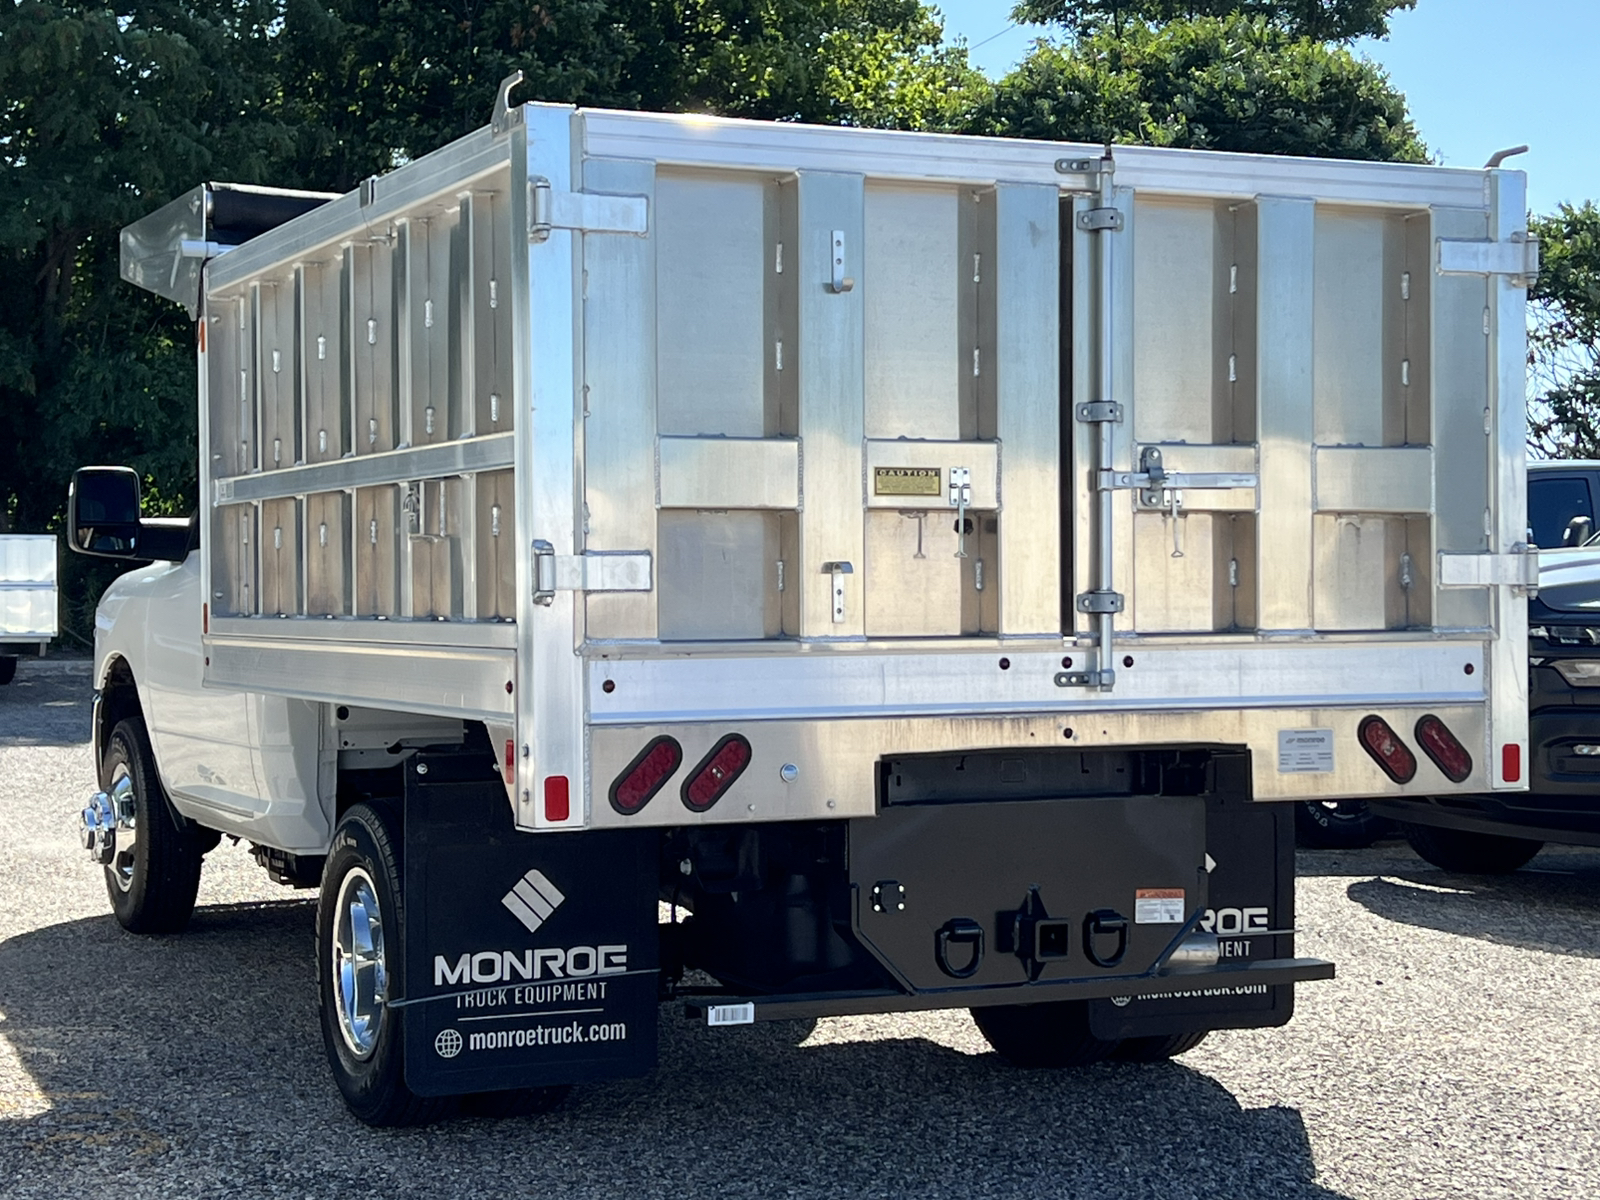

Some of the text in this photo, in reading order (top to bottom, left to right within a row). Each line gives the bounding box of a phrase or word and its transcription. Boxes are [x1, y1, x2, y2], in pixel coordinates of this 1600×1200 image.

[879, 469, 936, 477] CAUTION
[1200, 907, 1268, 933] ROE
[434, 945, 627, 985] MONROE
[456, 982, 608, 1008] TRUCK EQUIPMENT
[469, 1021, 626, 1050] monroetruck.com
